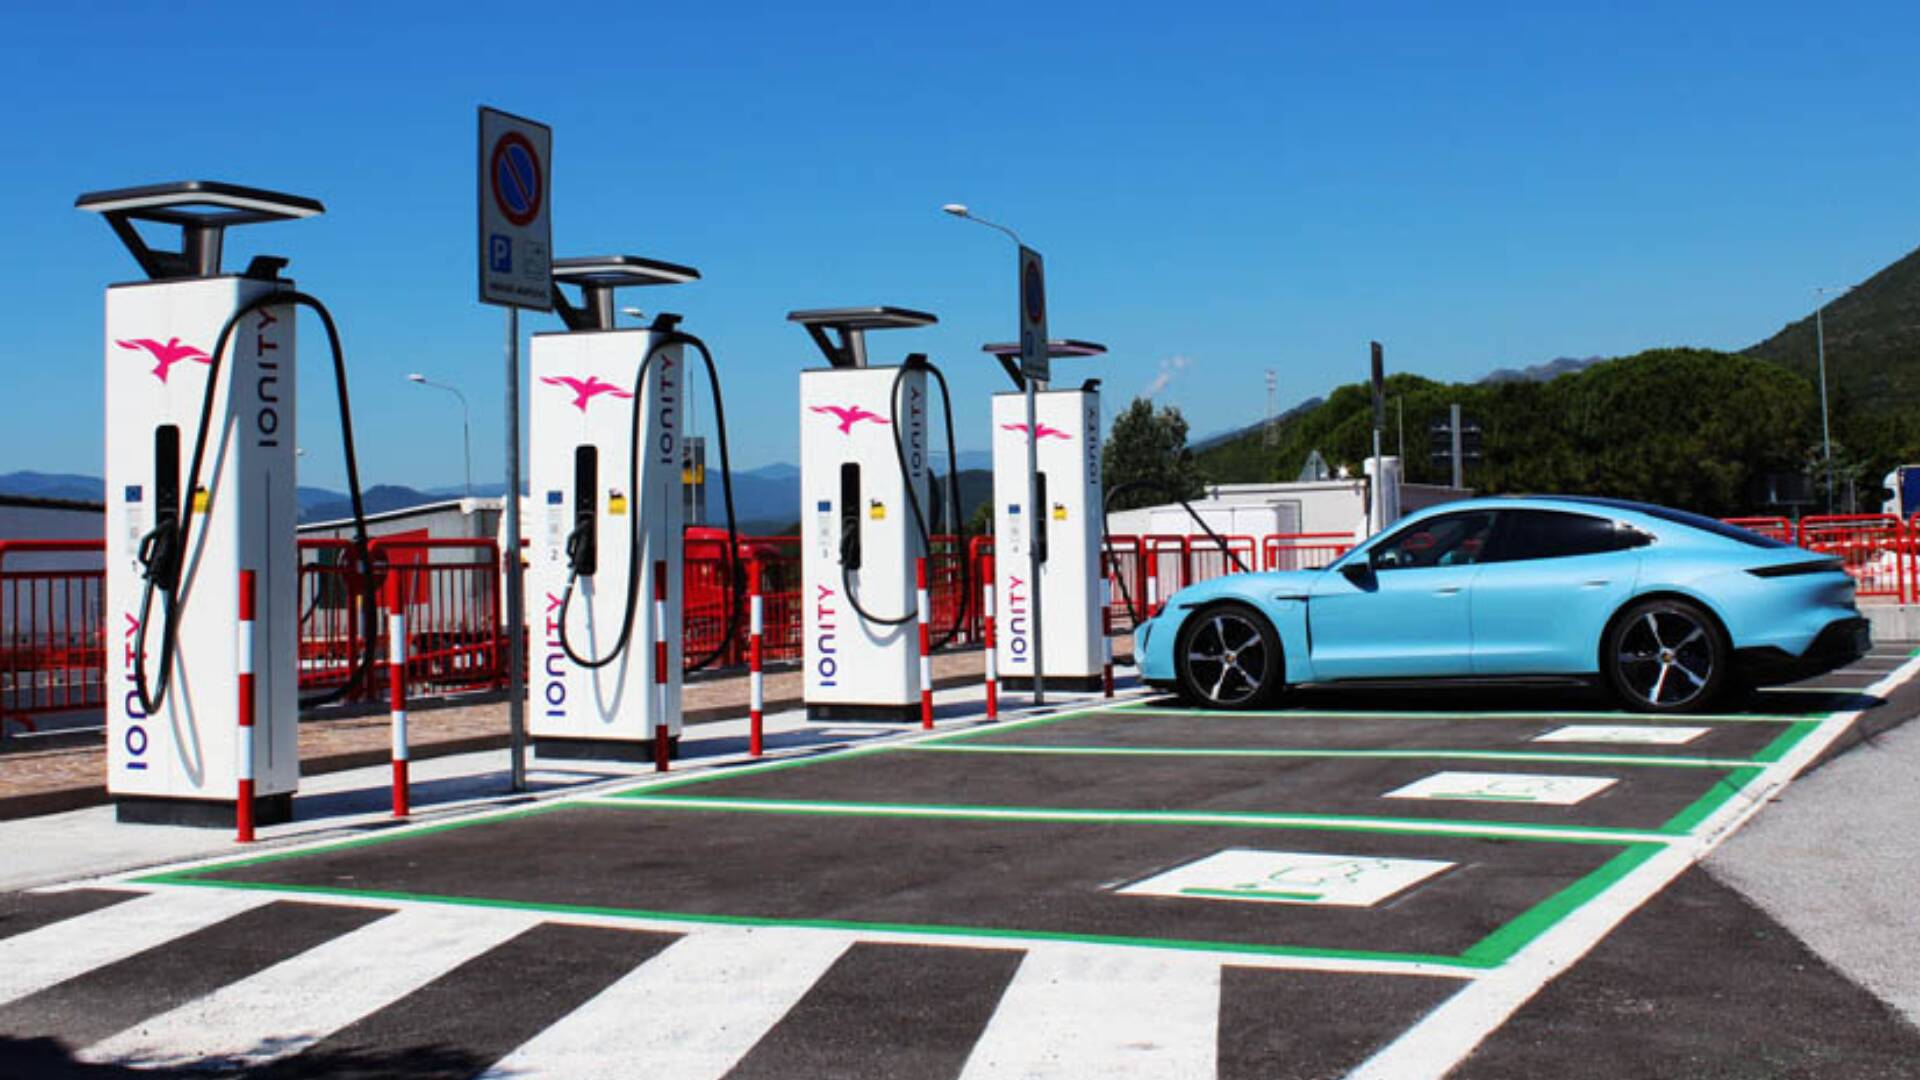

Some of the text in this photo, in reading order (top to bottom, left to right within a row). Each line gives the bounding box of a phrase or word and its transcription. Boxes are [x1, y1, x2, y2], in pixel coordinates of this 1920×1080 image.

[494, 239, 508, 268] P
[257, 308, 278, 447] IONITY
[661, 354, 674, 465] IONITY
[911, 387, 921, 479] IONITY
[546, 592, 566, 718] IONITY
[818, 584, 836, 687] IONITY
[1010, 576, 1025, 663] IONITY
[125, 612, 148, 771] IONITY
